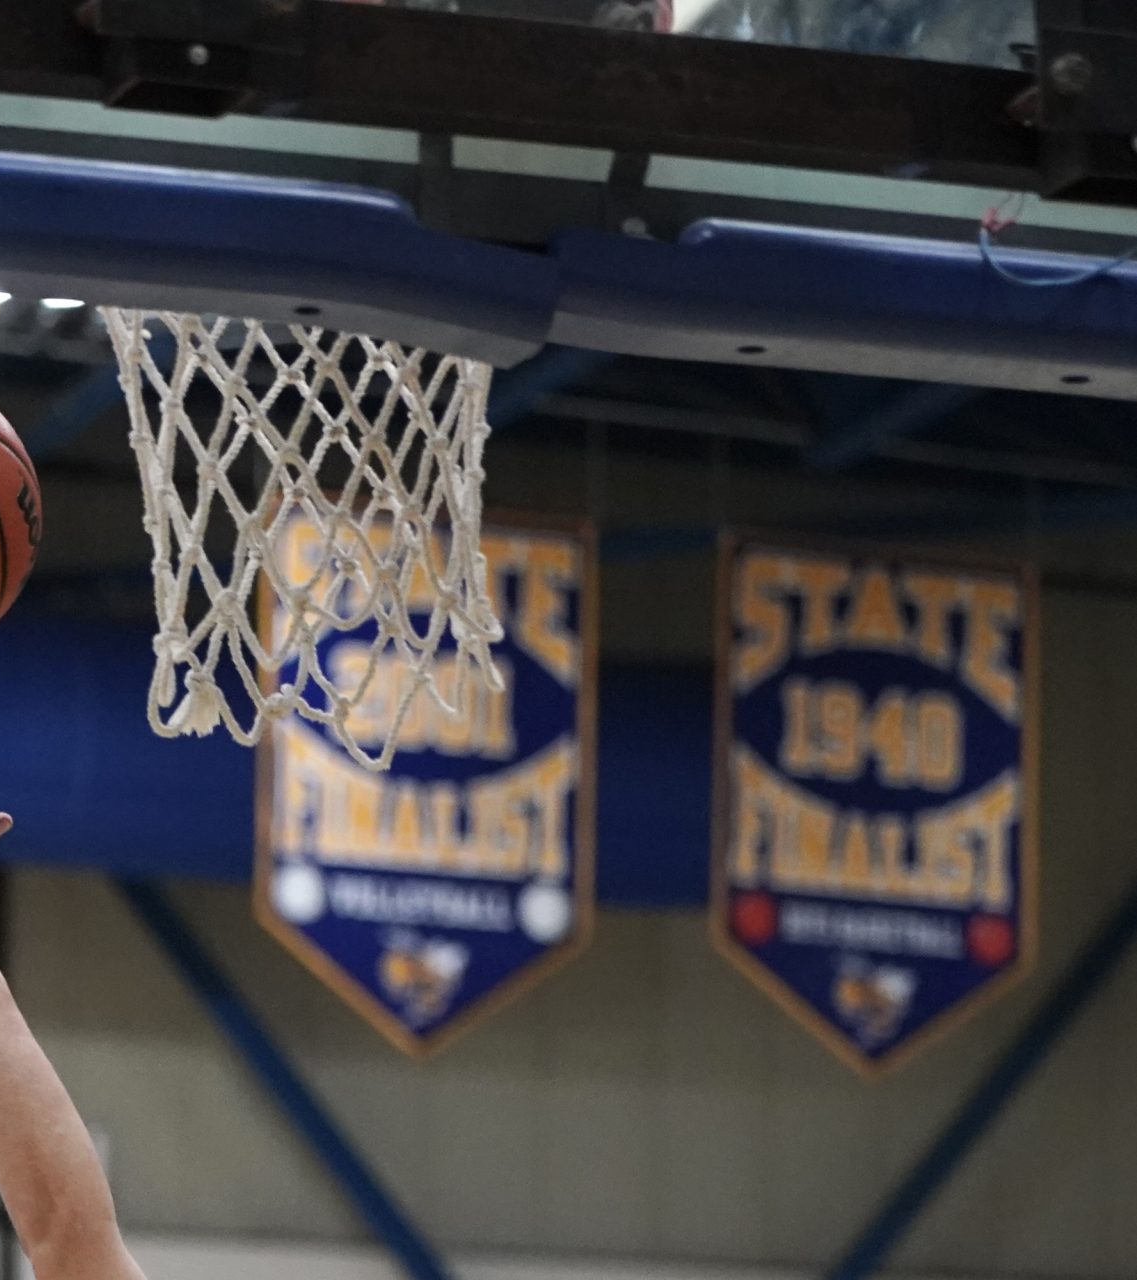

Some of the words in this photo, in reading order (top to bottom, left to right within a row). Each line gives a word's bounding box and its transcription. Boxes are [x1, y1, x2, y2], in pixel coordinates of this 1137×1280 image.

[731, 552, 1021, 723] STATE
[272, 720, 580, 886] FINALIST
[779, 675, 963, 793] 1940
[728, 742, 1021, 914] FINALIST
